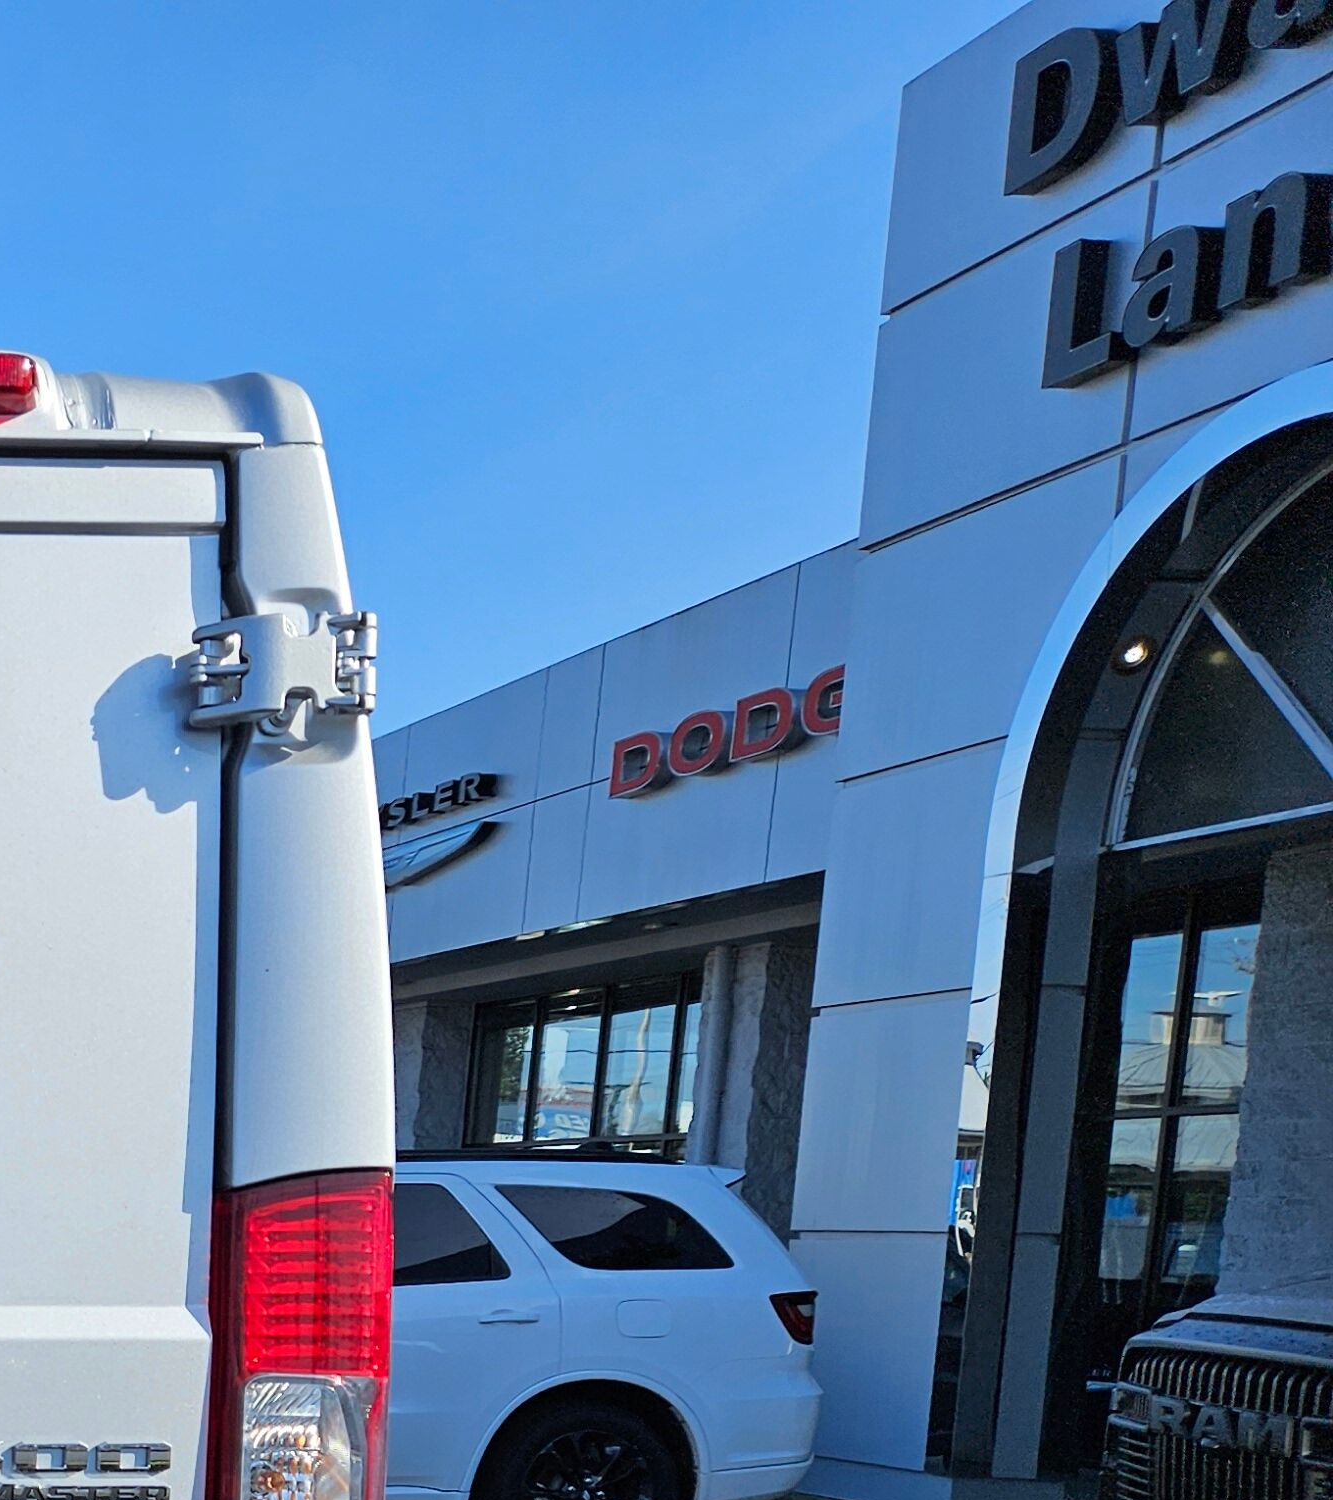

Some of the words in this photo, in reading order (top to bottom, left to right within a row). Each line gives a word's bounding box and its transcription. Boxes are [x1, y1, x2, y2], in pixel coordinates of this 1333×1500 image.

[609, 664, 845, 798] DODG
[380, 773, 481, 827] SLER
[1149, 1395, 1294, 1457] RAM
